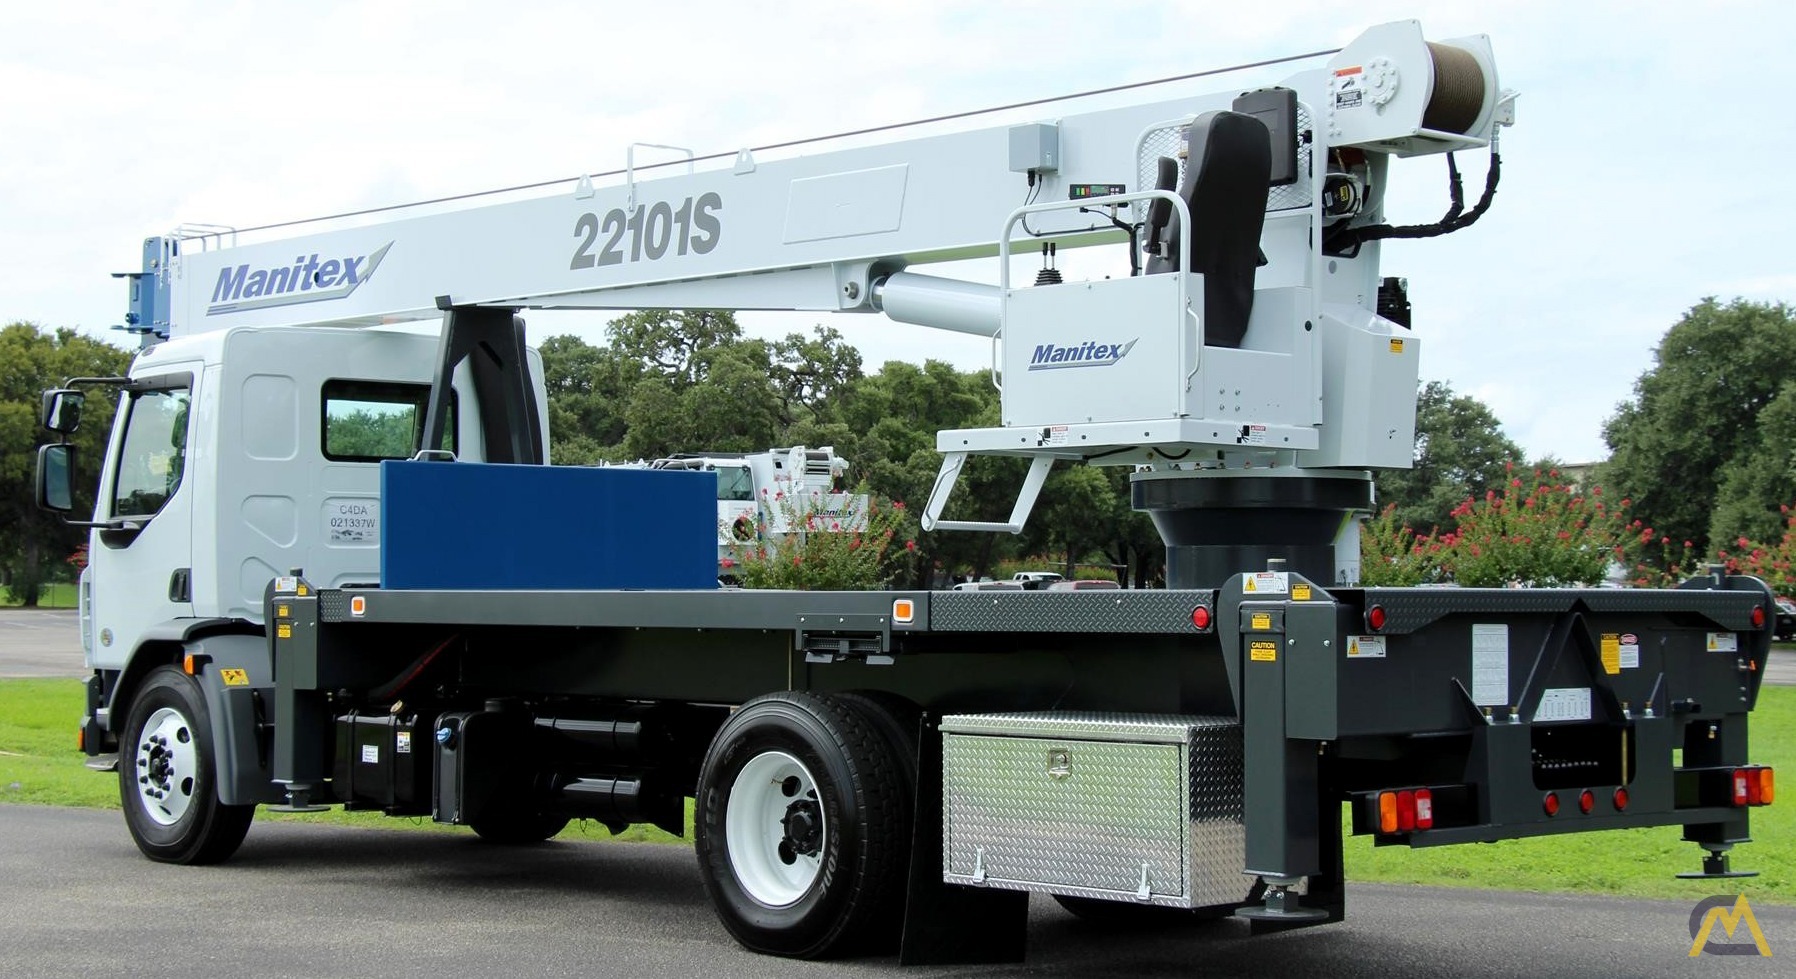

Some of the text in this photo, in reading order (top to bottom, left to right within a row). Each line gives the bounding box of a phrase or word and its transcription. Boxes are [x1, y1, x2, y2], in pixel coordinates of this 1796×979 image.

[570, 192, 722, 270] 22101S
[211, 254, 366, 303] Manitex
[1031, 341, 1122, 364] Manitex
[340, 505, 367, 515] C4DA
[815, 508, 853, 517] Manitx
[331, 518, 375, 528] 021337W
[1251, 641, 1275, 650] CAUTION
